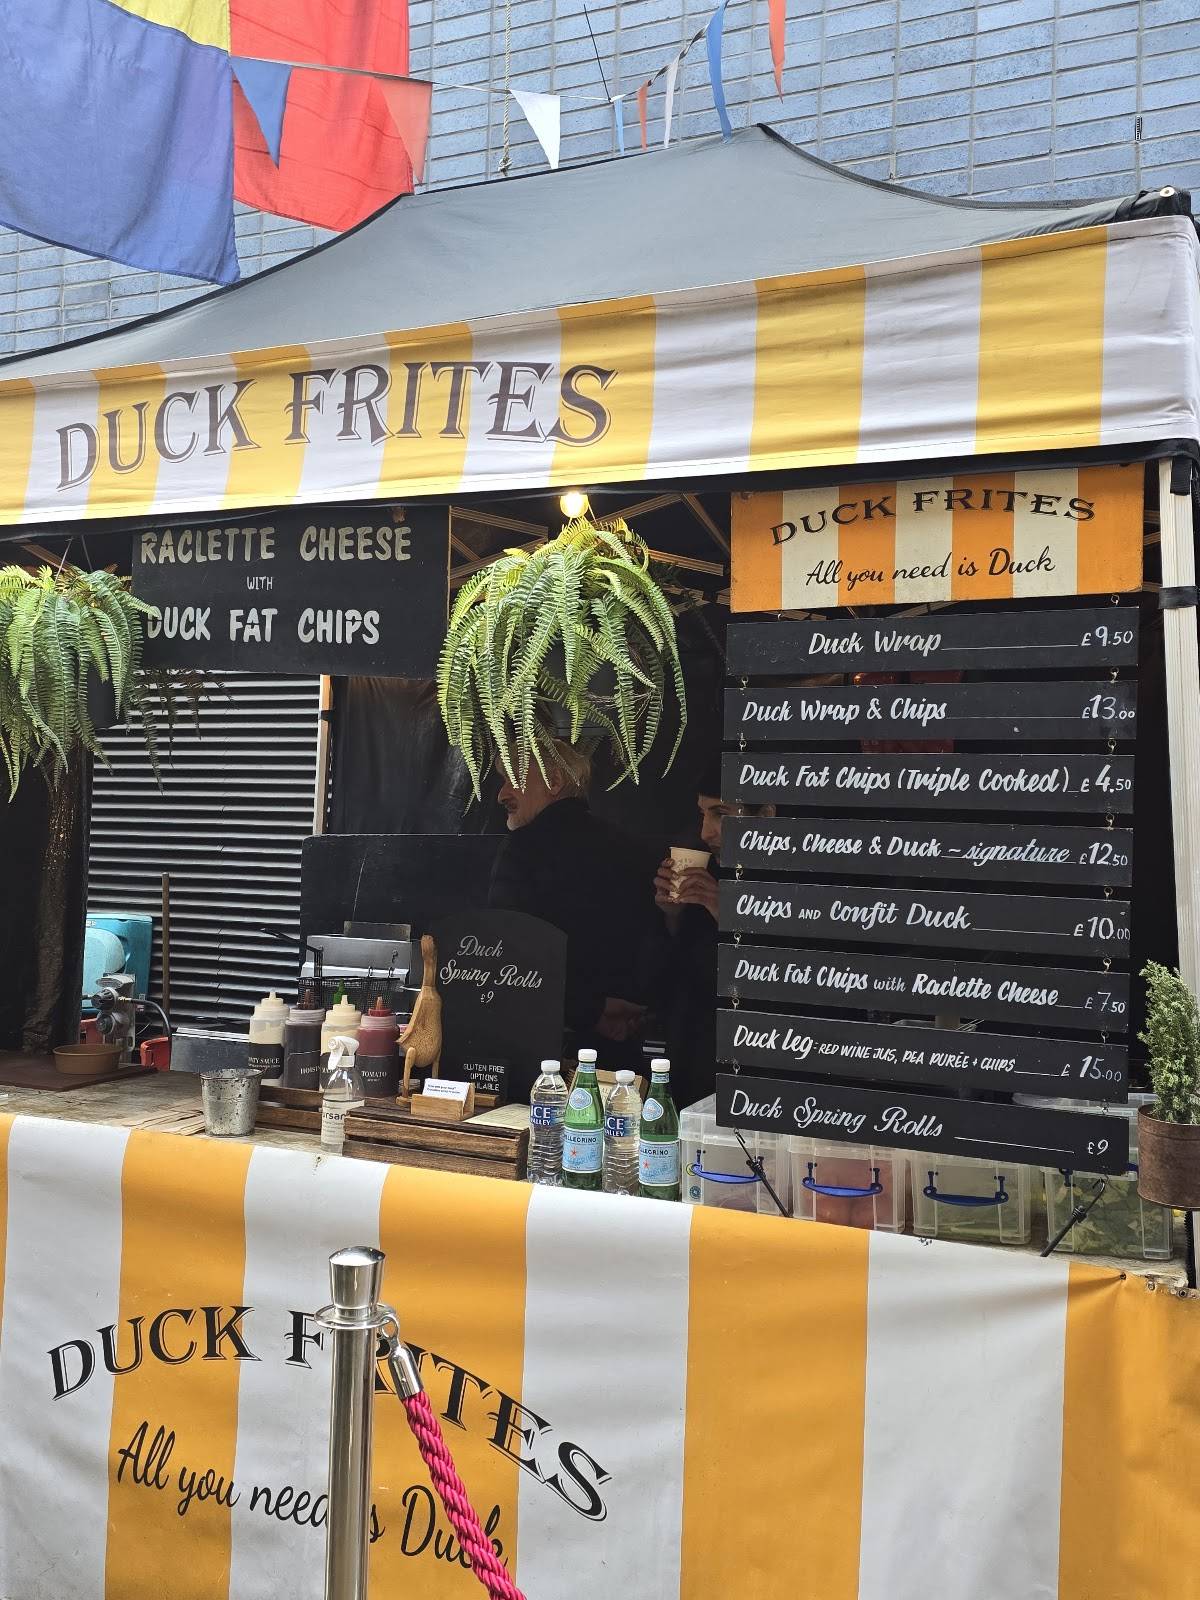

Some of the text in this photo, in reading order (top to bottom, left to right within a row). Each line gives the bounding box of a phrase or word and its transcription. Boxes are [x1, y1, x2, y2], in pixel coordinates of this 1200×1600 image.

[56, 361, 617, 493] DUCK FRITES
[769, 488, 1096, 545] DUCK FRITES
[141, 526, 412, 564] RACLETTE CHEESE
[246, 576, 273, 590] WITH
[805, 545, 1056, 591] All you need is Duck
[148, 606, 380, 645] DUCK FAT CHIPS
[808, 625, 1134, 657] Duck Wrap £9.50
[741, 694, 1136, 727] Duck Wrap & Chips £13.00
[739, 764, 790, 787] Duck
[795, 765, 830, 788] Fat
[835, 766, 891, 795] Chips
[897, 766, 970, 797] (Triple
[978, 766, 1069, 793] Cooked)
[740, 830, 797, 856] Chips,
[802, 833, 862, 854] Cheese
[868, 835, 882, 855] &
[886, 836, 942, 857] Duck
[963, 838, 1071, 867] signature
[1079, 842, 1128, 867] £12.50
[736, 894, 1131, 940] Chips AND Confit Duck £10.00
[456, 935, 504, 958] Duck
[440, 959, 543, 989] Spring Rolls
[735, 959, 780, 982] Duck
[784, 963, 811, 985] Fat
[816, 966, 868, 993] Chips
[873, 977, 906, 993] with
[912, 973, 992, 1000] Raclette
[997, 981, 1060, 1006] Cheese
[480, 991, 494, 1004] £9
[733, 1025, 781, 1050] Duck
[818, 1043, 840, 1055] RED
[840, 1045, 873, 1059] WINE
[872, 1048, 898, 1065] JUS,
[902, 1051, 924, 1065] PEA
[980, 1060, 1016, 1073] CHIPS
[361, 1070, 387, 1078] TOMATO
[470, 1072, 498, 1083] OPTIONS
[488, 1064, 505, 1074] FREE
[530, 1105, 551, 1119] ICE
[730, 1090, 1109, 1155] Duck Spring Rolls £9
[47, 1306, 262, 1401] DUCK
[117, 1421, 176, 1490] All
[177, 1466, 241, 1516] you
